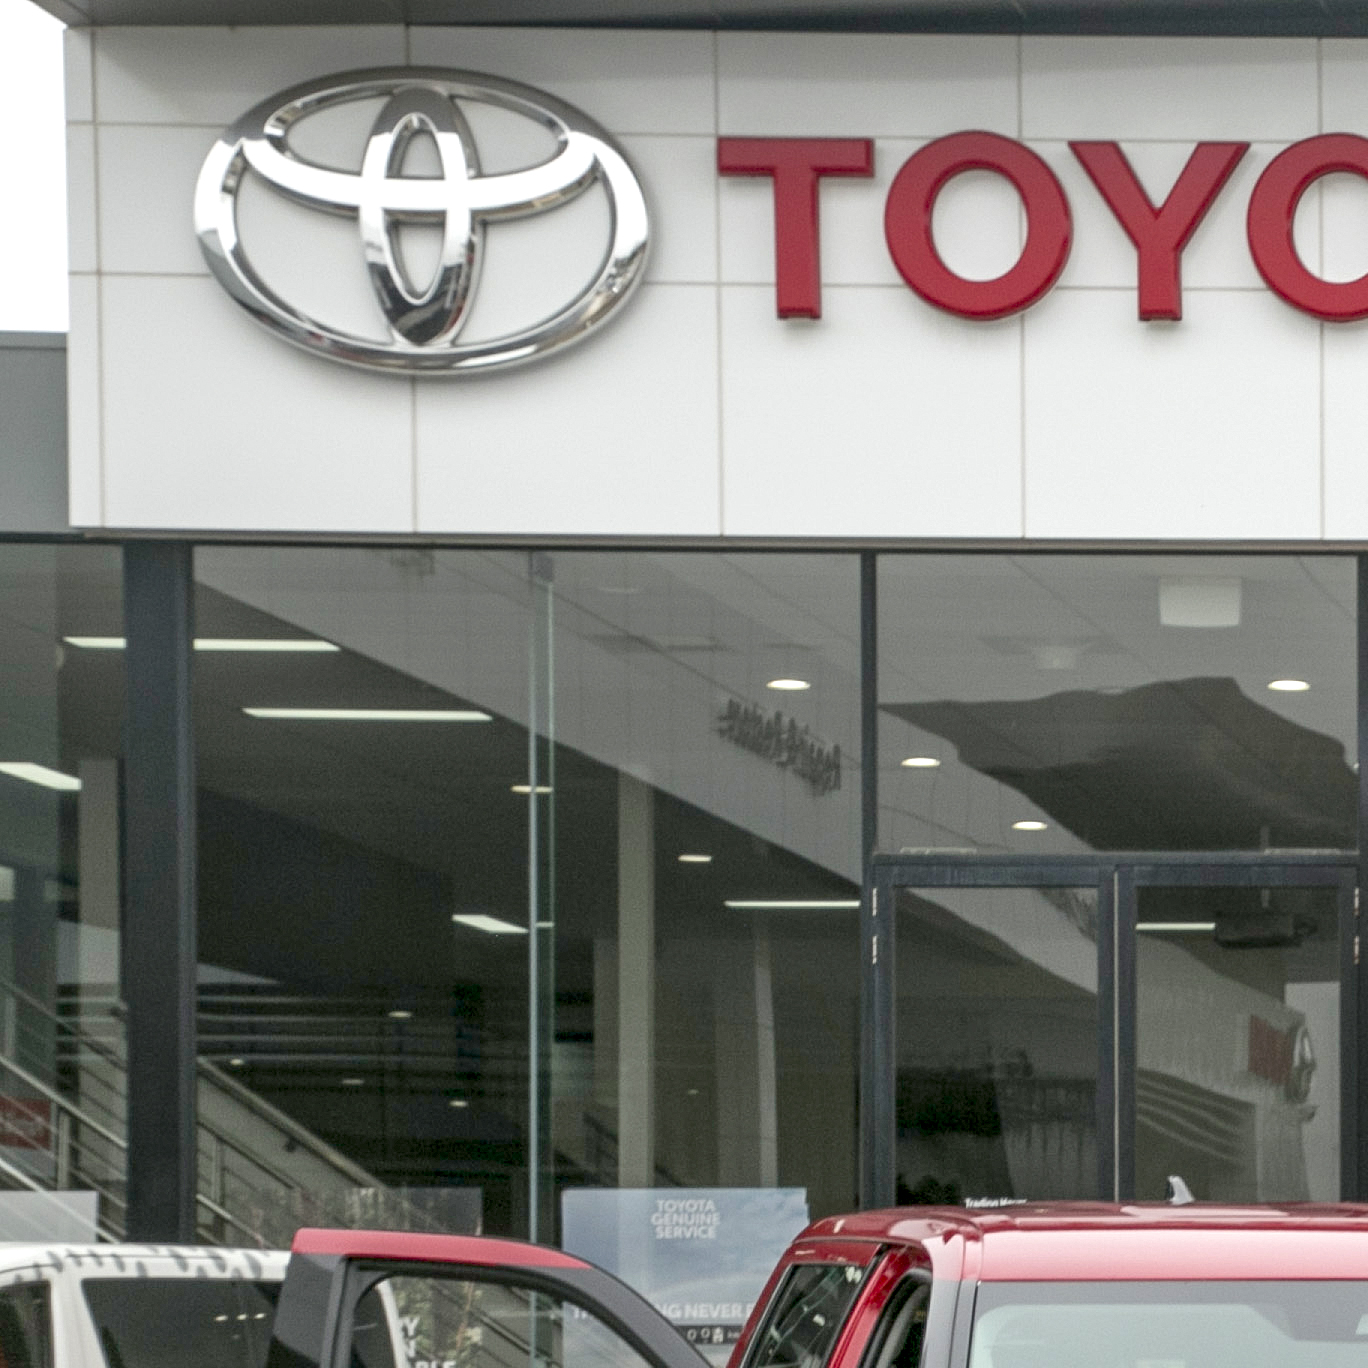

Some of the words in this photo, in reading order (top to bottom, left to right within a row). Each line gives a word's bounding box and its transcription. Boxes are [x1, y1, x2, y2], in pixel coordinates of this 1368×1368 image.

[657, 1200, 716, 1212] TOYOTA
[651, 1212, 720, 1226] GENUINE
[655, 1226, 717, 1239] SERVICE
[684, 1303, 743, 1319] NEVER
